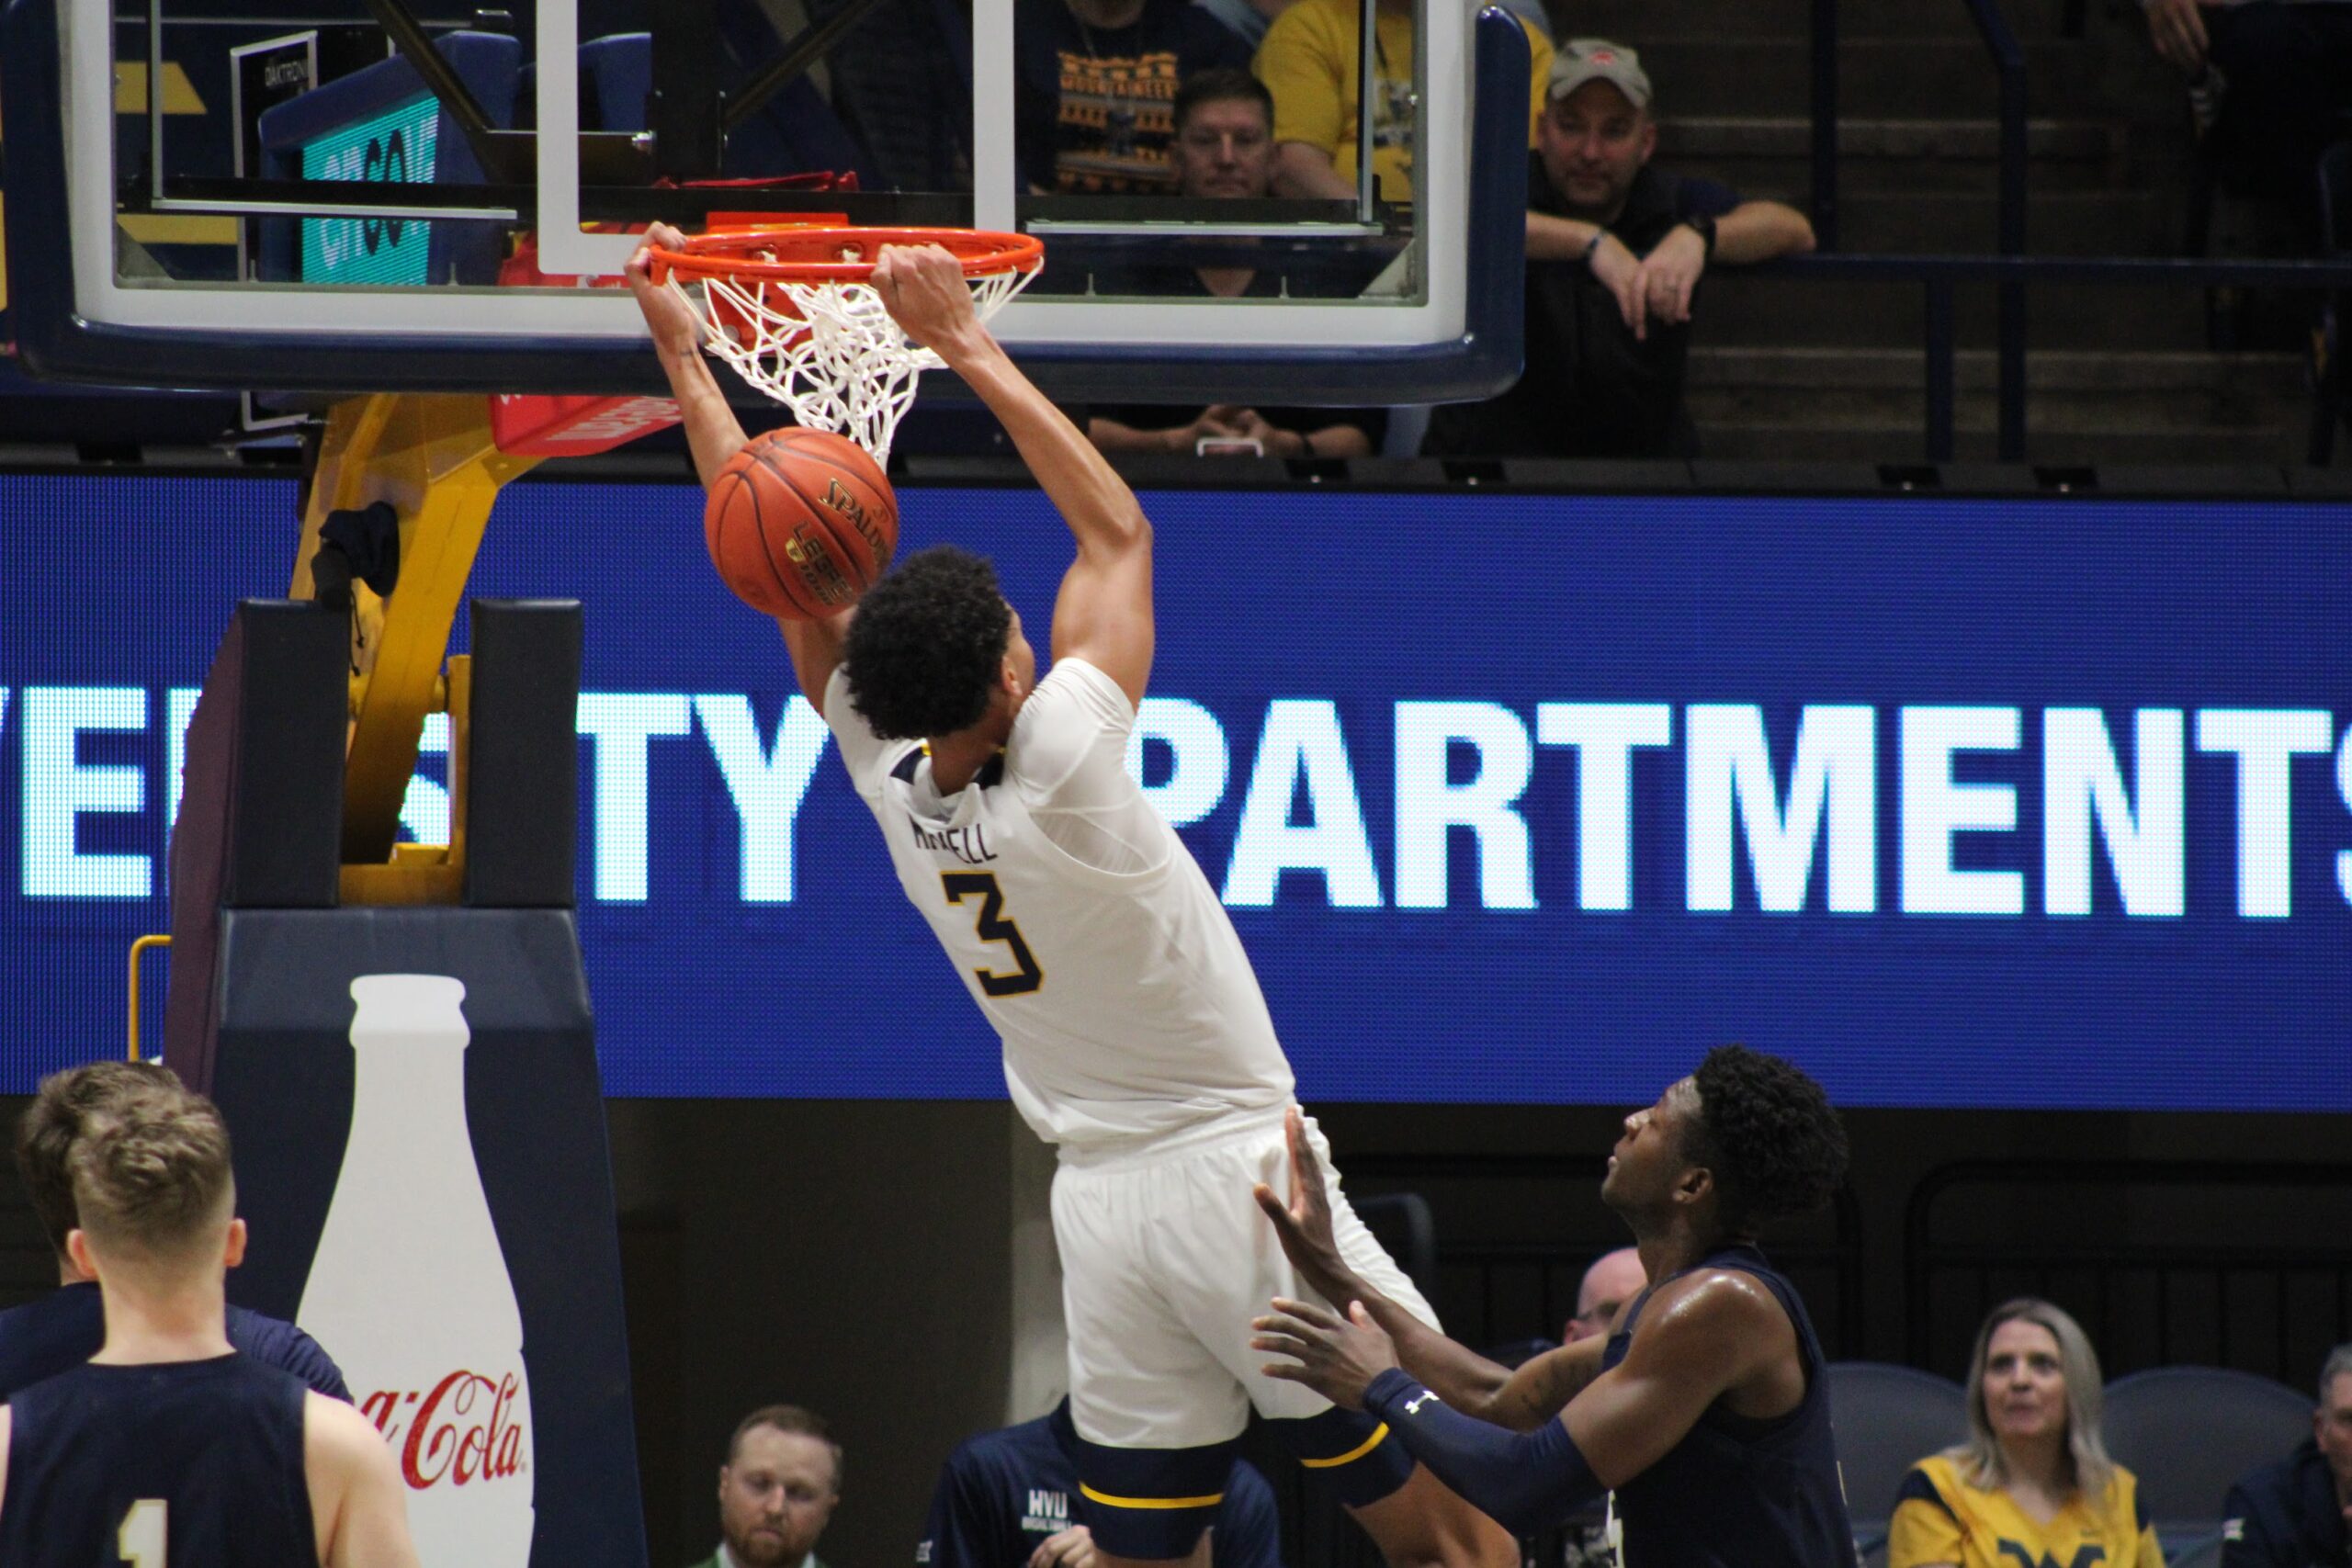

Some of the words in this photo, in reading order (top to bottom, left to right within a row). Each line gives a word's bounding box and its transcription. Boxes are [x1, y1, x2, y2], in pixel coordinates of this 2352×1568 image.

[1123, 696, 2352, 918] PARTMENT
[938, 870, 1045, 998] 3
[360, 1370, 523, 1490] a-Cola
